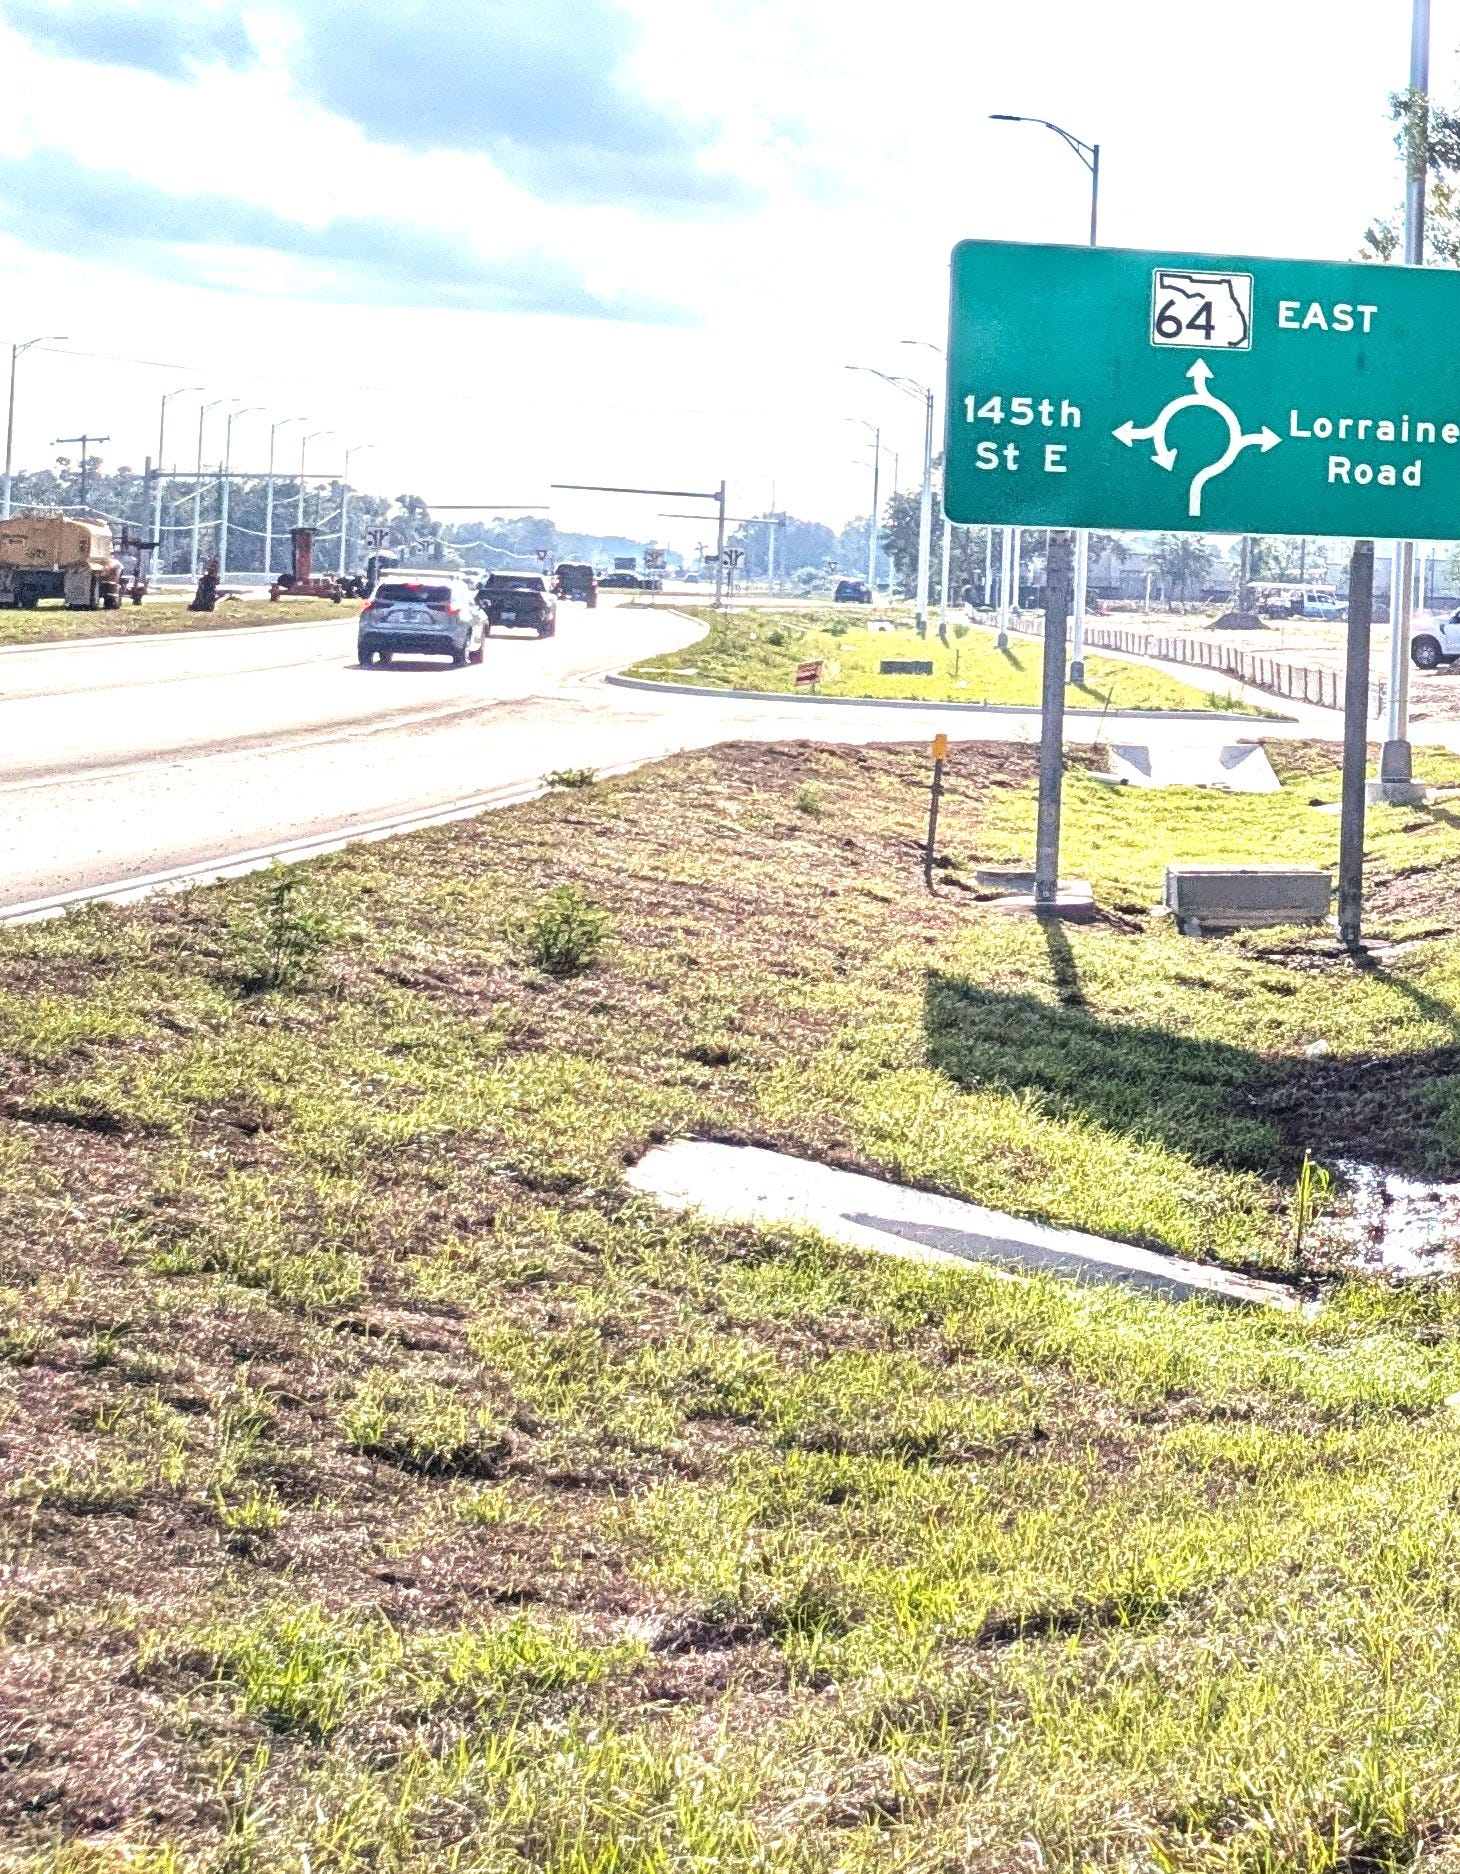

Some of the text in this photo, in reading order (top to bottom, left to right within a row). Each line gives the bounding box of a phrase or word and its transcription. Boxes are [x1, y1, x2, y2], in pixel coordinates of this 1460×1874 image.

[1155, 298, 1379, 341] 64 EAST
[963, 394, 1082, 428] 145th
[1289, 409, 1460, 444] Lorraine
[974, 441, 1068, 473] St E
[1326, 455, 1423, 488] Road
